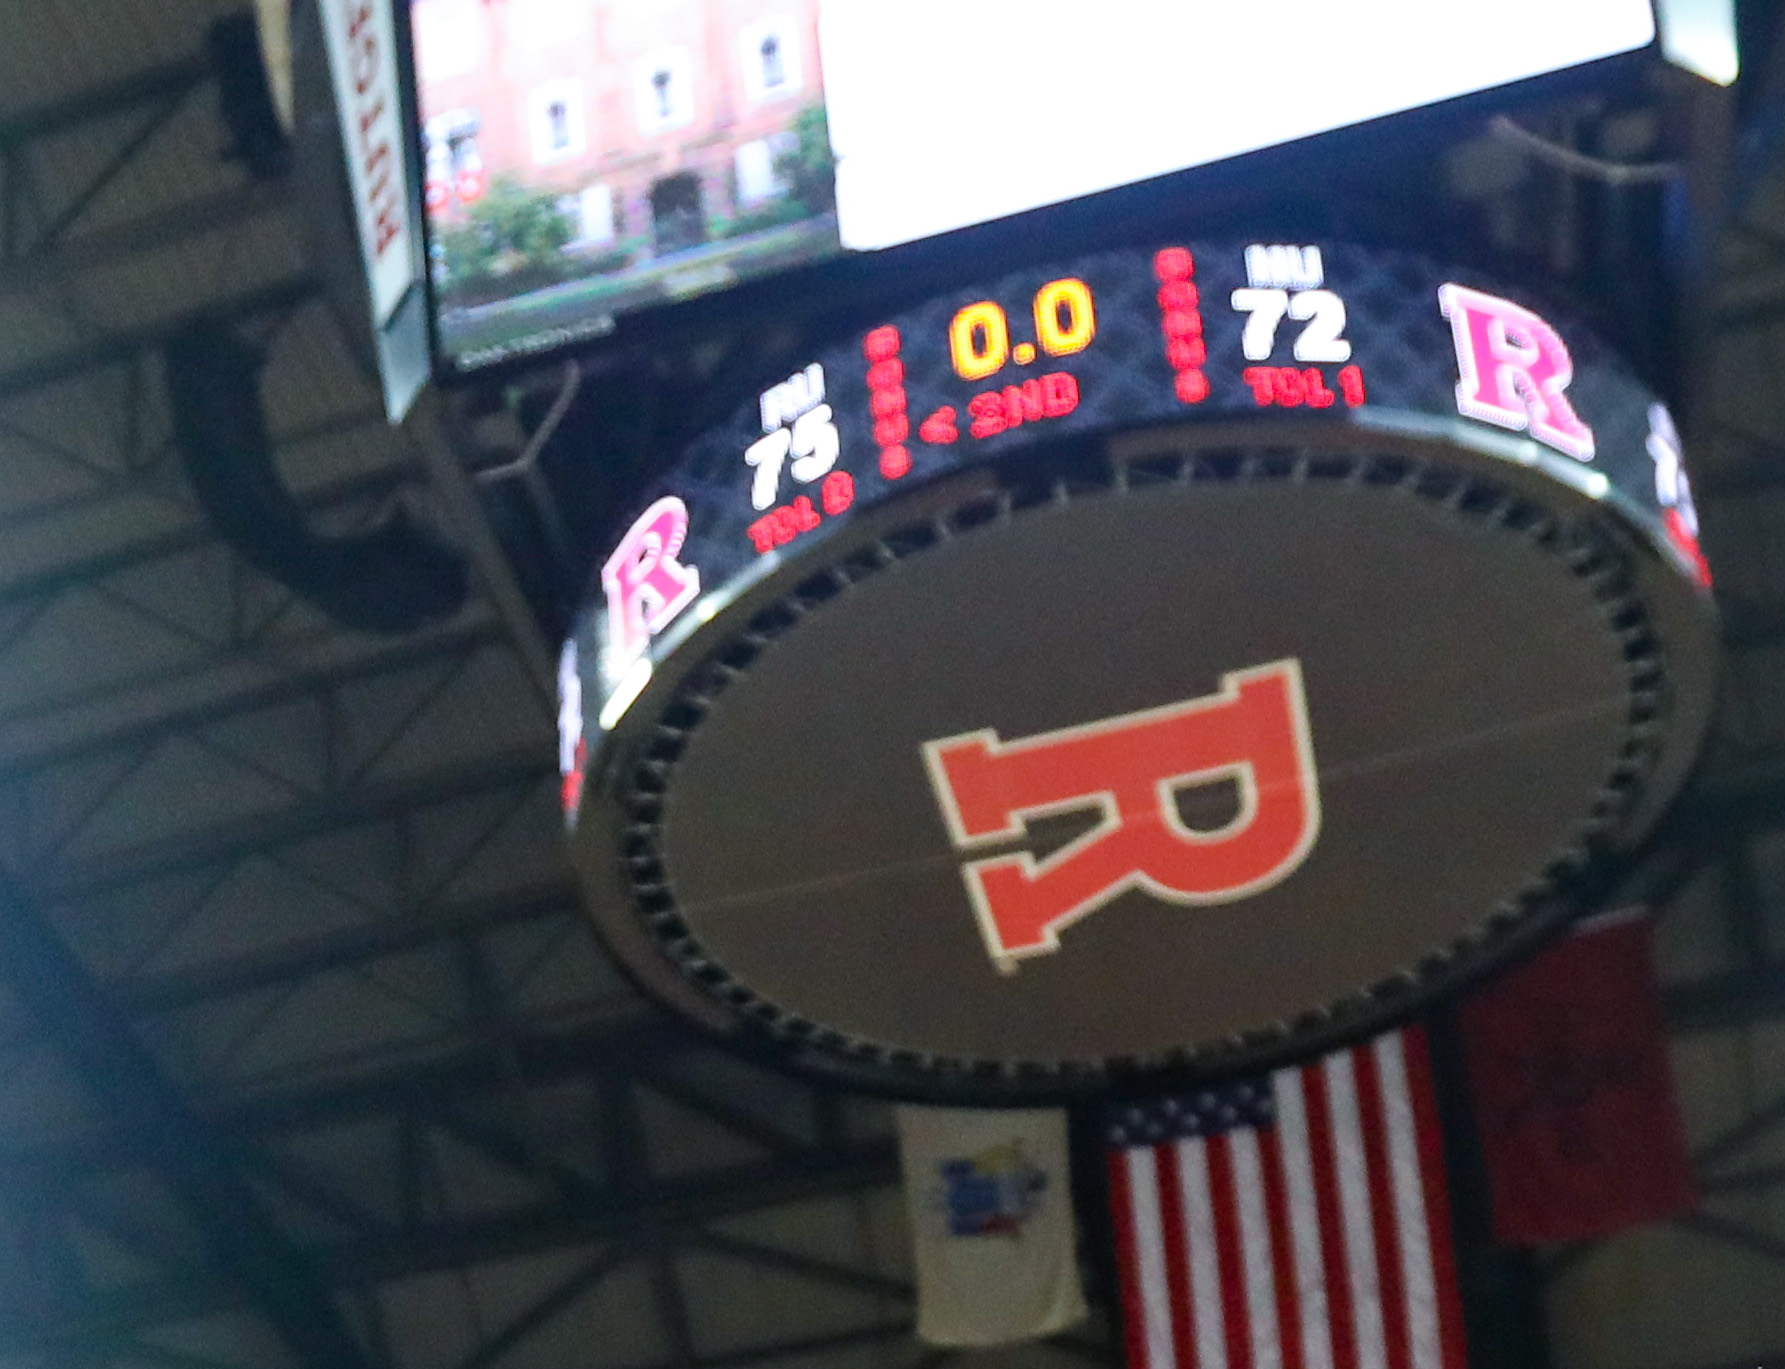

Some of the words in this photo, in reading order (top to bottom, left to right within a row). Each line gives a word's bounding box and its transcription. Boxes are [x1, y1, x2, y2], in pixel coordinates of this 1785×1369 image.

[950, 278, 1094, 381] 0.0
[1230, 287, 1352, 363] 72
[1439, 283, 1595, 462] R
[744, 403, 841, 511] 75
[921, 657, 1321, 964] R
